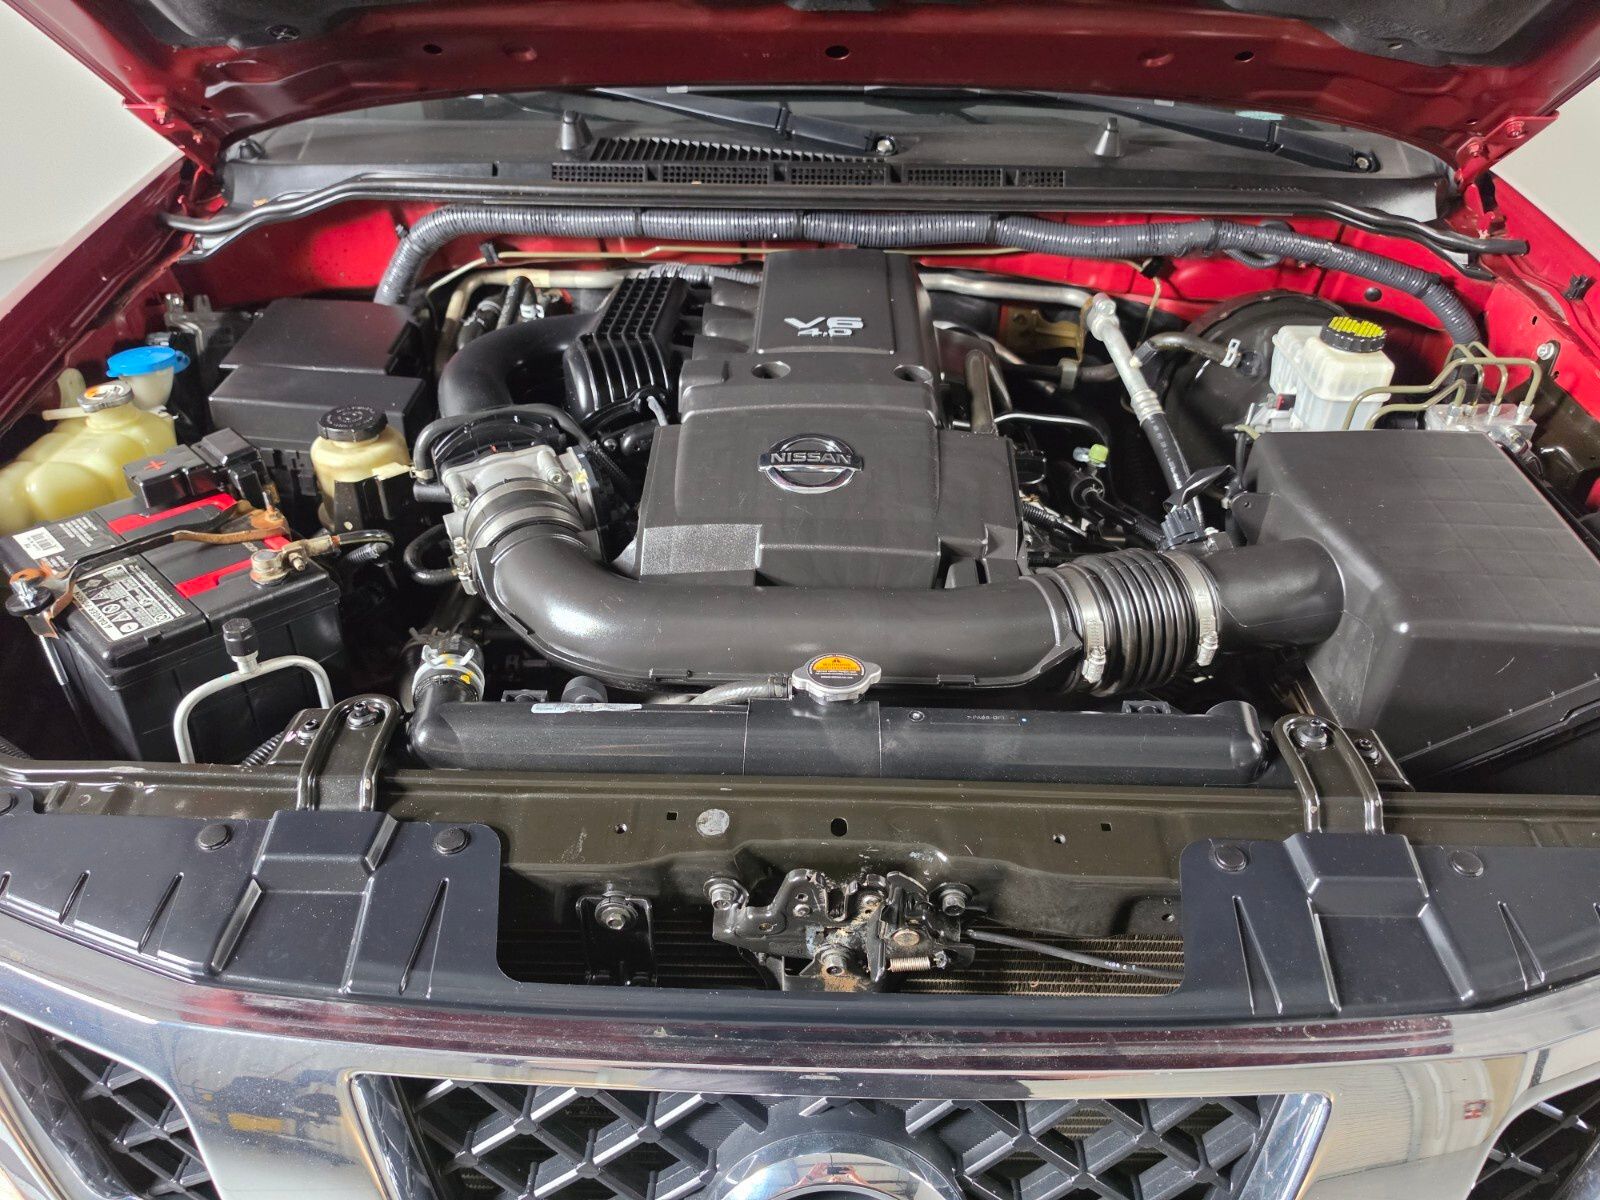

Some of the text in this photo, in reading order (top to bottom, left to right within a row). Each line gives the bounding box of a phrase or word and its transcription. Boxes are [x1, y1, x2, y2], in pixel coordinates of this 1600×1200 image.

[783, 316, 864, 329] V6
[797, 328, 853, 338] 4.0
[770, 451, 853, 464] NISSAN
